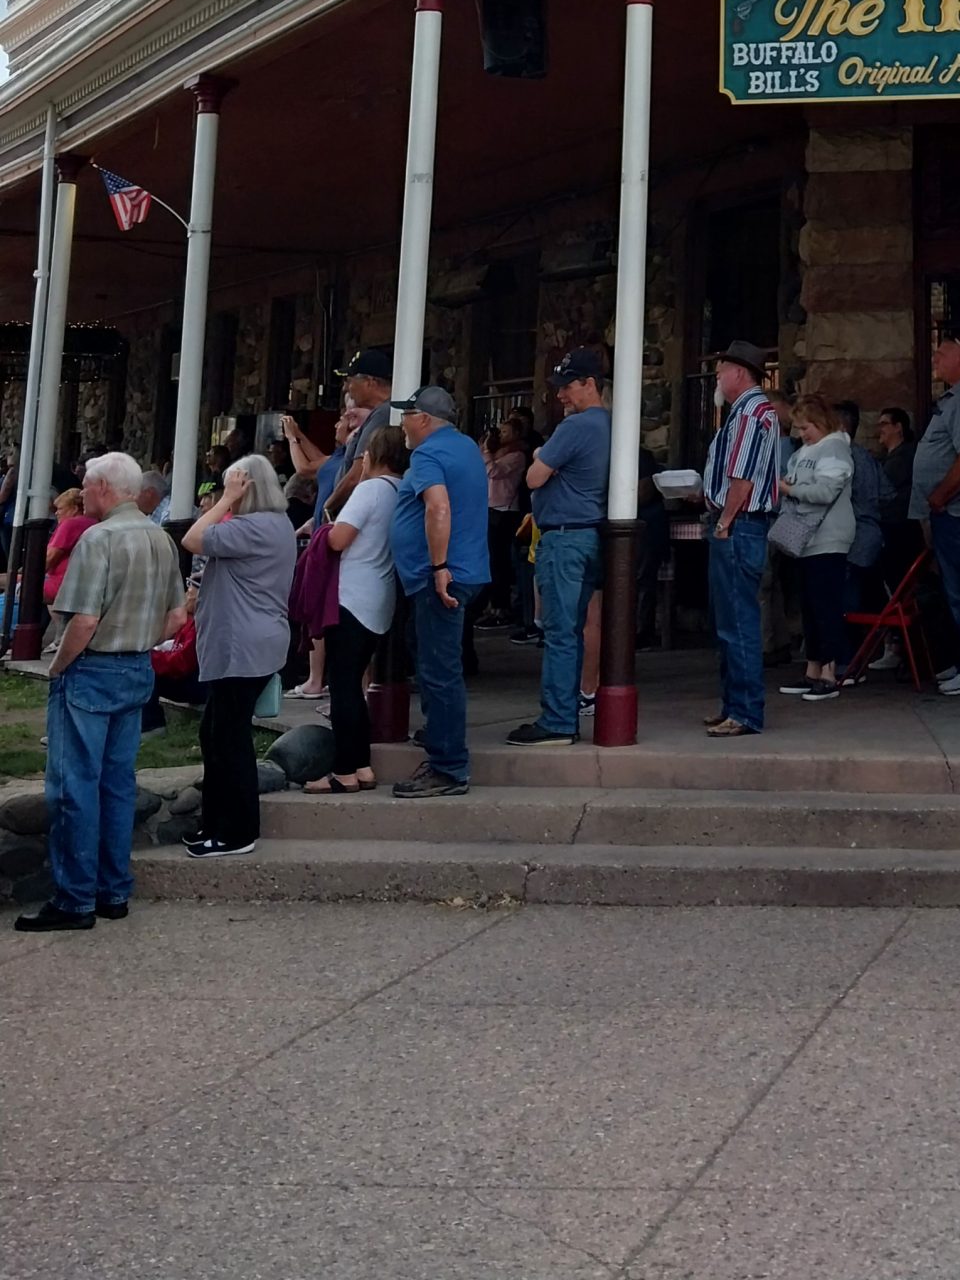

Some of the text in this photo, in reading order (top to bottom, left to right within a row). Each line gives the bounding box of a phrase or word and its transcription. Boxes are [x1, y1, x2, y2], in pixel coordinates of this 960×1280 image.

[732, 41, 838, 66] BUFFALO
[748, 68, 820, 94] BILL'S
[838, 55, 939, 93] Original
